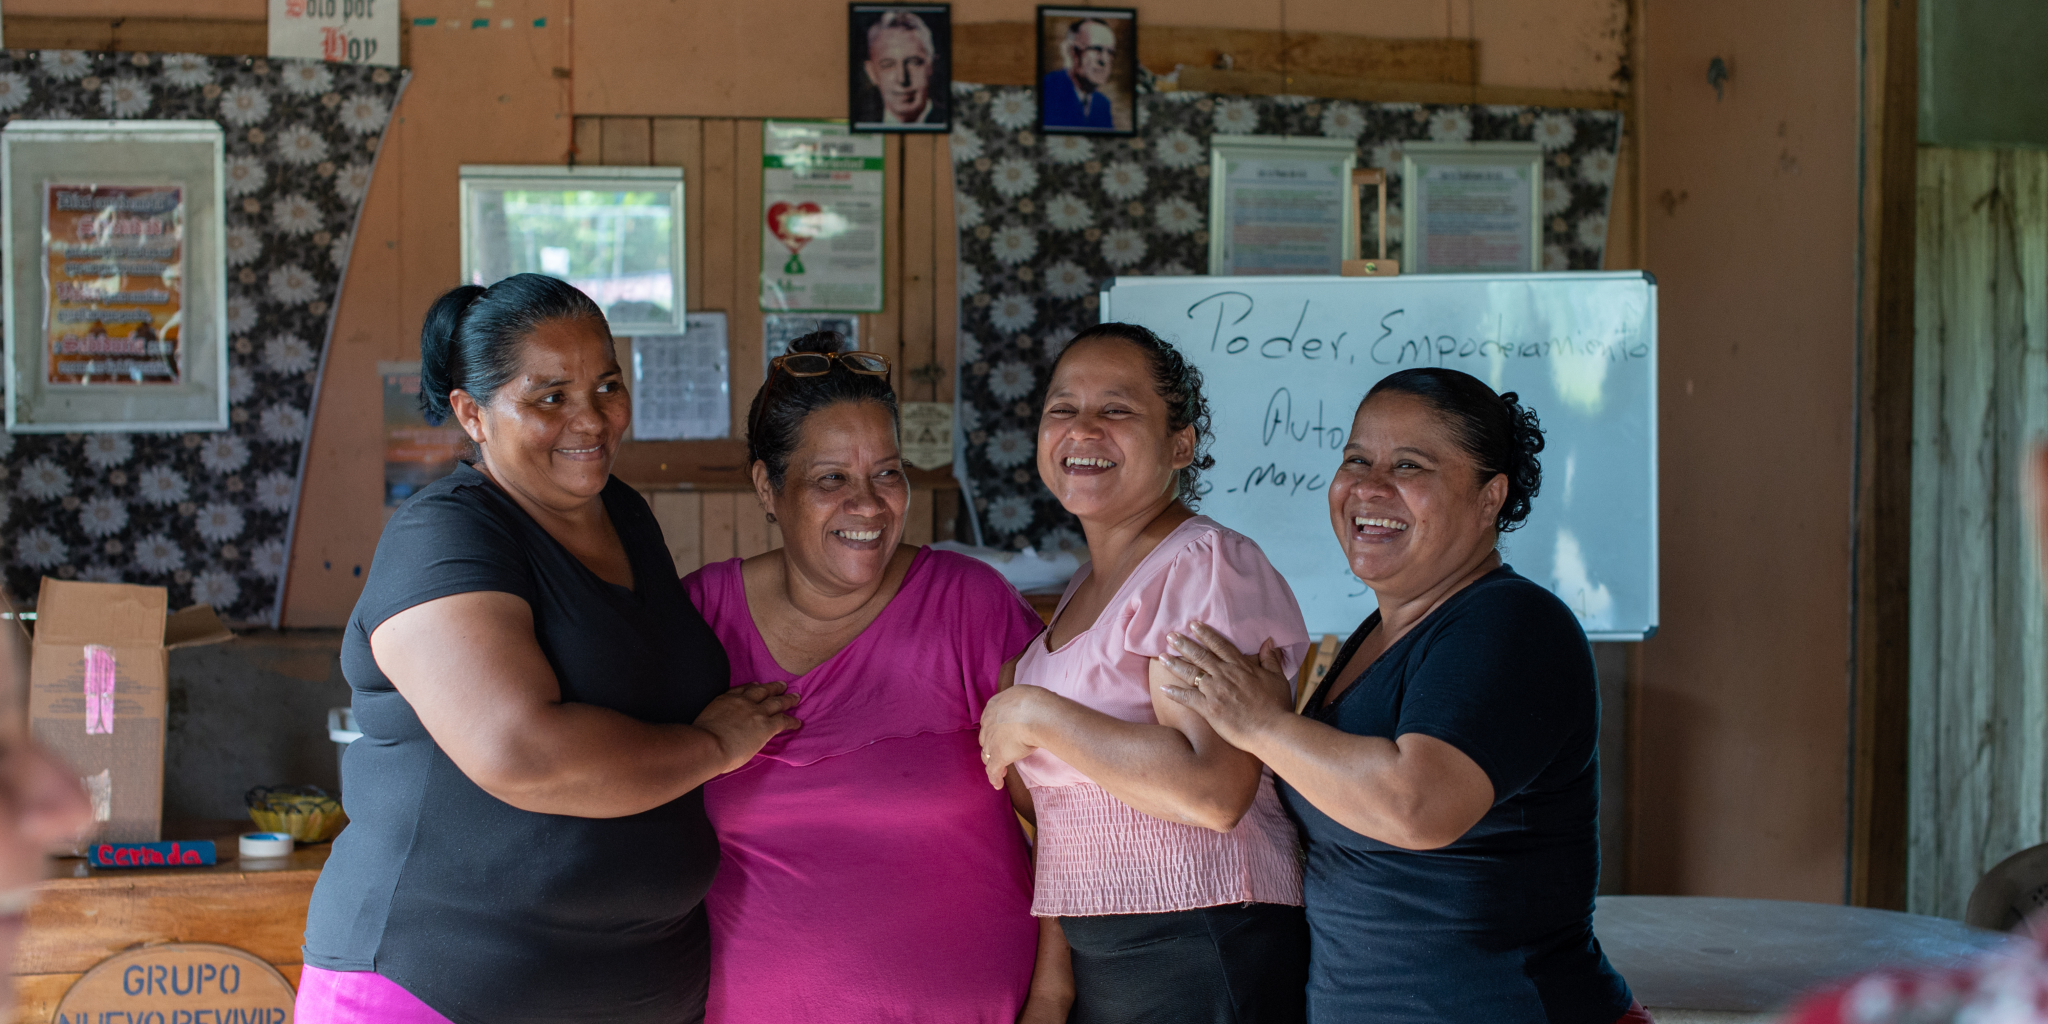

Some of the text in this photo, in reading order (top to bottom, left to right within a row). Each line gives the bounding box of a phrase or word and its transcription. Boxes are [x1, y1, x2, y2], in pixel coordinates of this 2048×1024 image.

[1187, 291, 1649, 366] Poder, Empoderamiento
[123, 964, 240, 996] GRUPO
